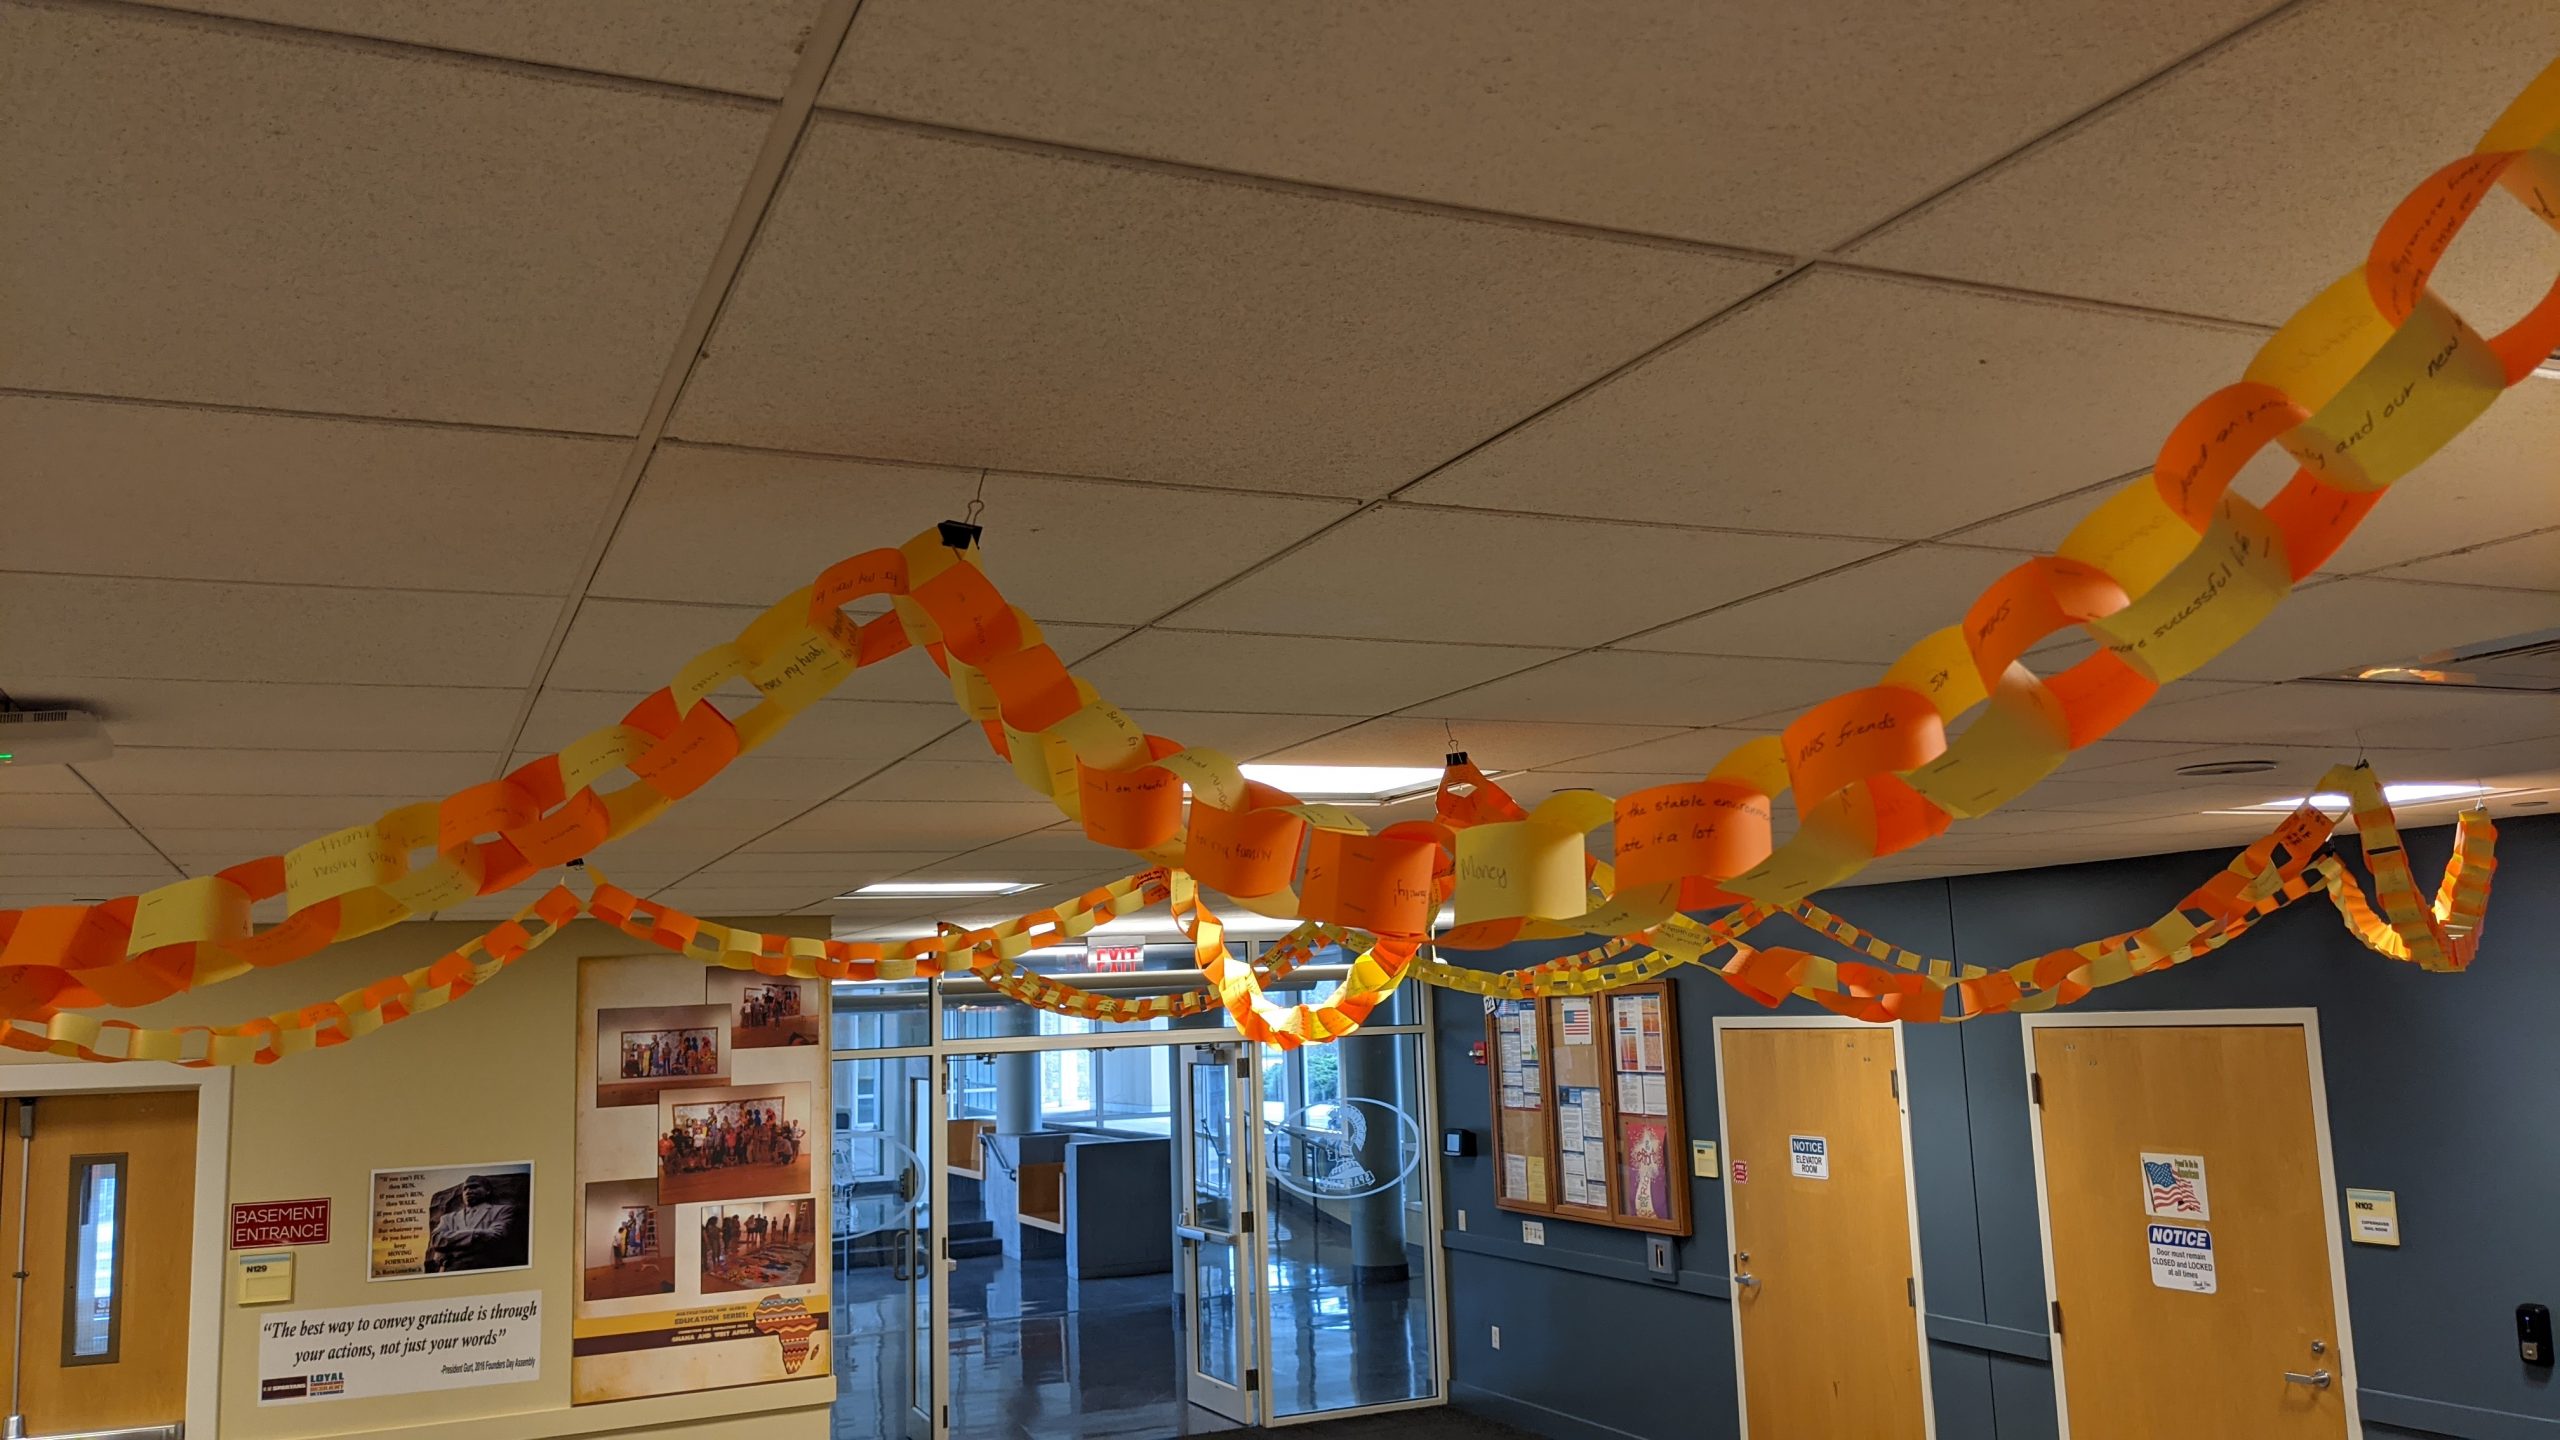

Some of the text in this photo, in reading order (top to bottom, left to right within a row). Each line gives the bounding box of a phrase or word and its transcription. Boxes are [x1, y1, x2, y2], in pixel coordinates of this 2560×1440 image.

[2336, 411, 2374, 453] and
[2384, 382, 2415, 418] our
[2427, 337, 2458, 378] new
[2153, 563, 2232, 638] successful
[1836, 712, 1896, 748] friends
[1628, 801, 1647, 817] the
[1655, 795, 1703, 813] stable
[1666, 833, 1679, 843] a
[1461, 855, 1507, 889] Money
[1096, 947, 1139, 973] EXIT
[1793, 1140, 1824, 1153] NOTICE
[1795, 1155, 1823, 1166] ELEVATOR
[1801, 1164, 1818, 1173] ROOM
[236, 1205, 326, 1225] BASEMENT
[2355, 1201, 2374, 1210] N102
[236, 1223, 324, 1242] ENTRANCE
[2152, 1227, 2207, 1247] NOTICE
[2156, 1248, 2206, 1261] Door must remain
[246, 1264, 268, 1274] N129
[2152, 1257, 2213, 1272] CLOSED and LOCKED
[2168, 1268, 2199, 1279] at all times
[264, 1300, 537, 1338] “The best way to convey gratitude is through
[293, 1328, 507, 1367] your actions, not just your words”
[310, 1371, 344, 1383] LOYAL
